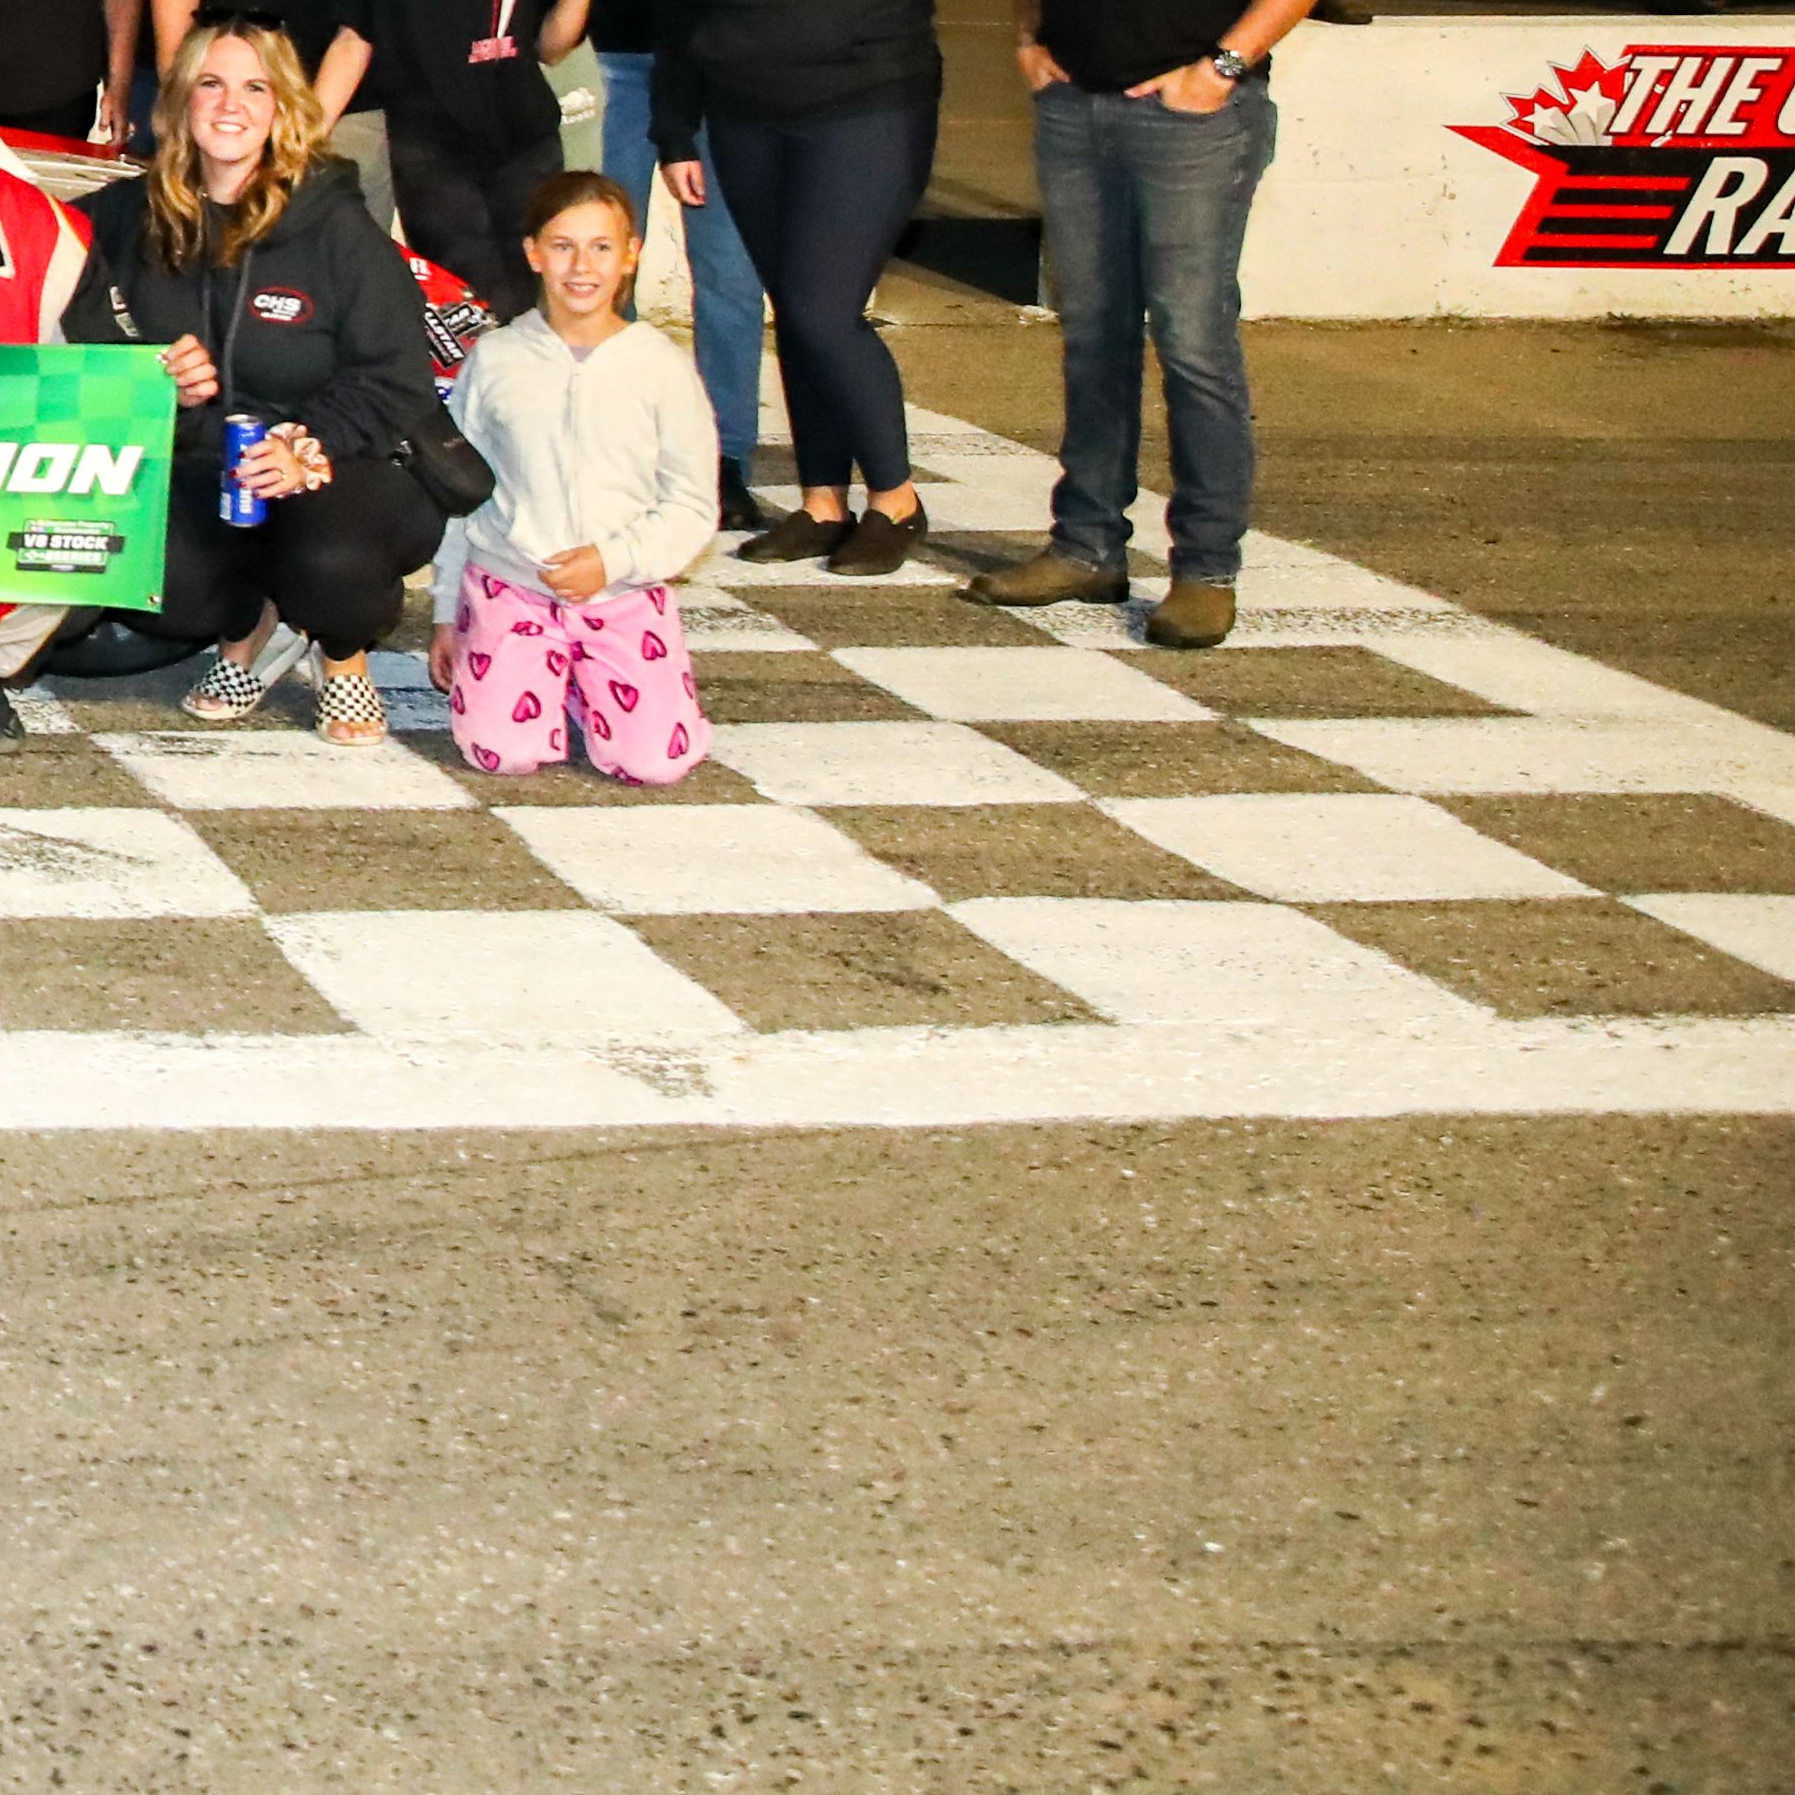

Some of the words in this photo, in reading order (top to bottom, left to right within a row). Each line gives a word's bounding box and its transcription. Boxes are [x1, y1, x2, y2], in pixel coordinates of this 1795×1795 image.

[1609, 55, 1787, 136] THE
[23, 533, 49, 548] V8
[50, 535, 109, 550] STOCK
